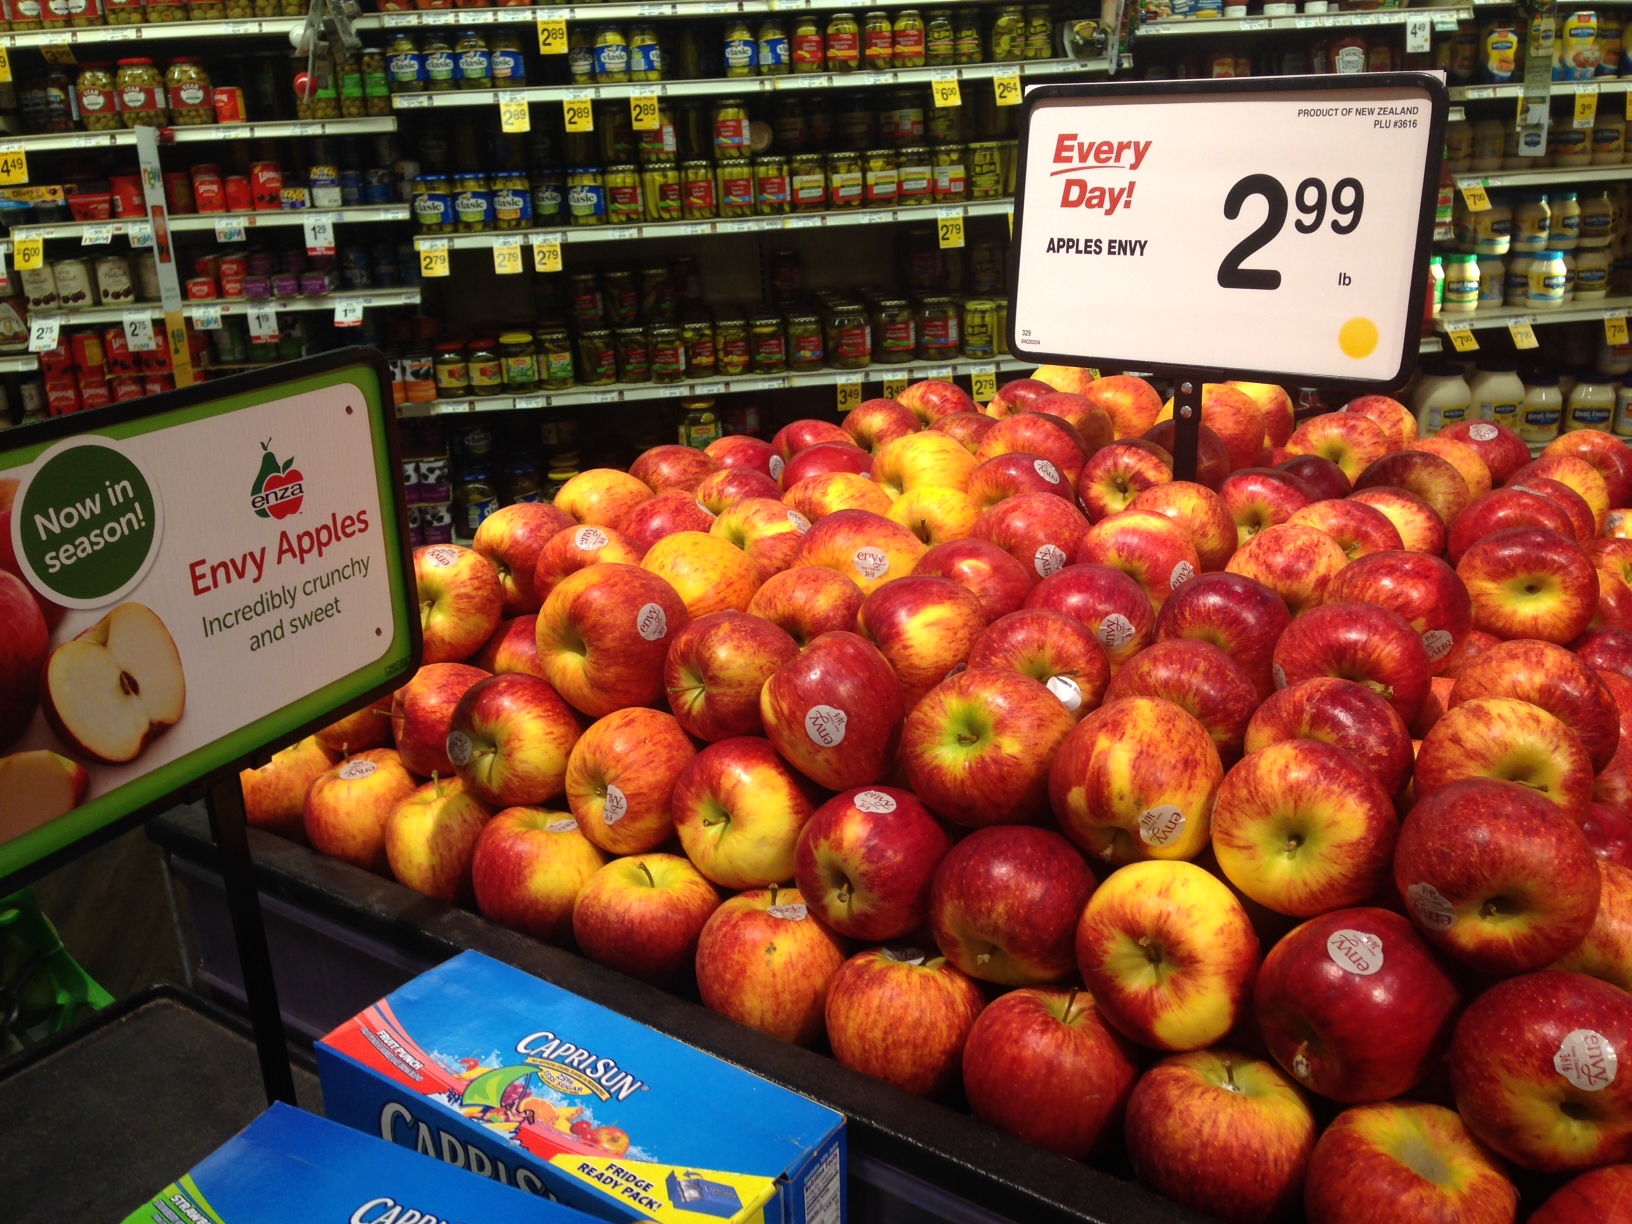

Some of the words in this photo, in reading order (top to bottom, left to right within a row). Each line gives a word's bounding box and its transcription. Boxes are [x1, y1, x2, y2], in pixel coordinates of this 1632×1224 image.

[1297, 108, 1338, 118] PRODUCT
[1340, 108, 1353, 117] OF
[1355, 107, 1375, 117] NEW
[1376, 106, 1419, 116] ZEALAND
[1373, 119, 1391, 130] PLU
[1392, 119, 1418, 129] #3616
[1052, 133, 1152, 171] Every
[1060, 178, 1136, 216] Day!
[1046, 237, 1103, 256] APPLES
[1107, 239, 1148, 257] ENVY
[1338, 272, 1352, 287] lb
[33, 493, 101, 541] Now
[104, 476, 134, 508] in
[251, 481, 304, 510] enza
[43, 502, 146, 574] season!
[189, 546, 267, 596] Envy
[276, 508, 370, 566] Apples
[857, 552, 886, 568] envy
[202, 584, 299, 638] Incredibly
[302, 555, 371, 598] crunchy
[249, 620, 286, 652] and
[290, 596, 343, 635] sweet
[640, 605, 660, 633] envy
[1106, 617, 1122, 647] envy
[809, 710, 834, 745] envy
[864, 790, 894, 811] envy
[1150, 812, 1182, 845] envy
[1330, 934, 1370, 972] envy
[1580, 1034, 1609, 1086] envy
[577, 1162, 621, 1191] READY
[622, 1186, 663, 1212] PACK!
[604, 1162, 654, 1193] FRIDGE
